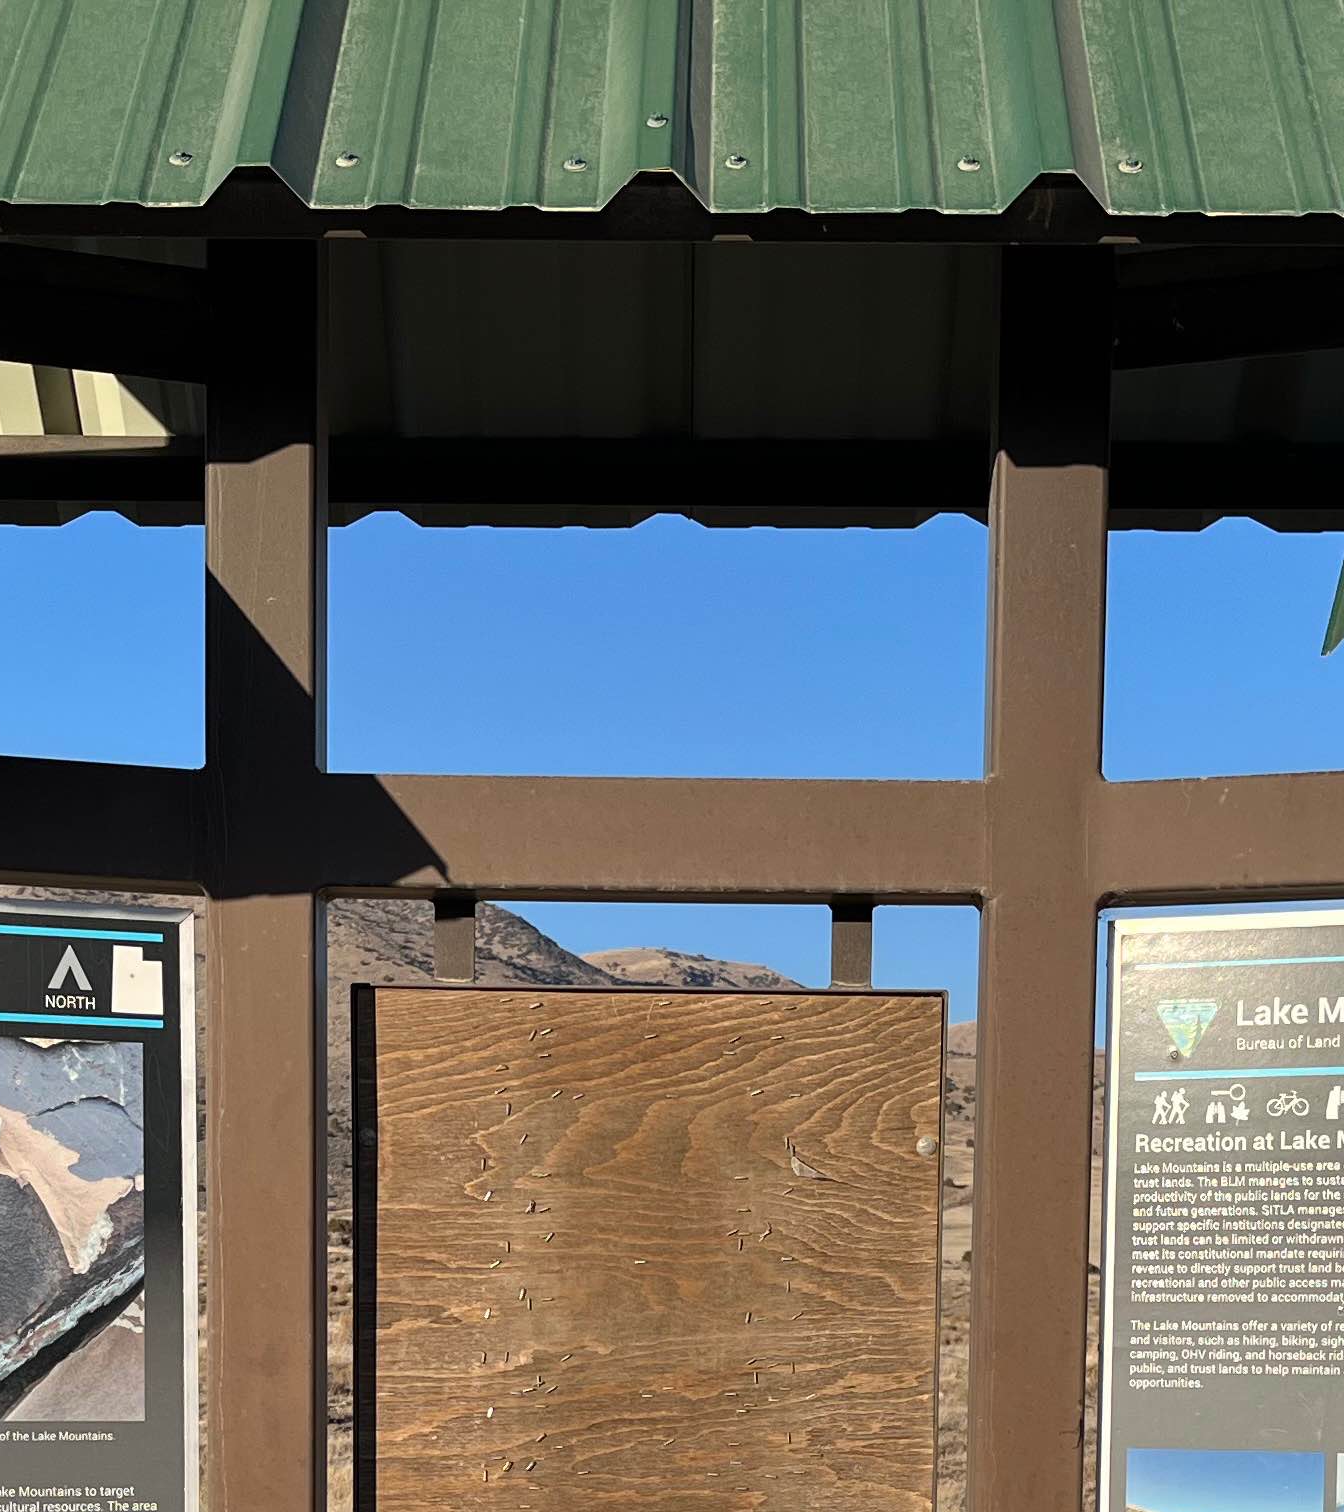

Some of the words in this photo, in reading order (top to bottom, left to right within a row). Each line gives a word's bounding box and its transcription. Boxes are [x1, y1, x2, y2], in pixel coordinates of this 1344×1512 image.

[45, 994, 96, 1010] NORTH
[1234, 991, 1308, 1026] Lake
[1235, 1033, 1284, 1050] Bureau
[1289, 1035, 1303, 1049] of
[1307, 1034, 1340, 1049] Land
[1136, 1131, 1246, 1153] Recreation
[1253, 1132, 1274, 1151] at
[1281, 1130, 1330, 1150] Lake
[0, 1431, 10, 1441] of
[13, 1432, 29, 1441] the
[32, 1431, 56, 1441] Lake
